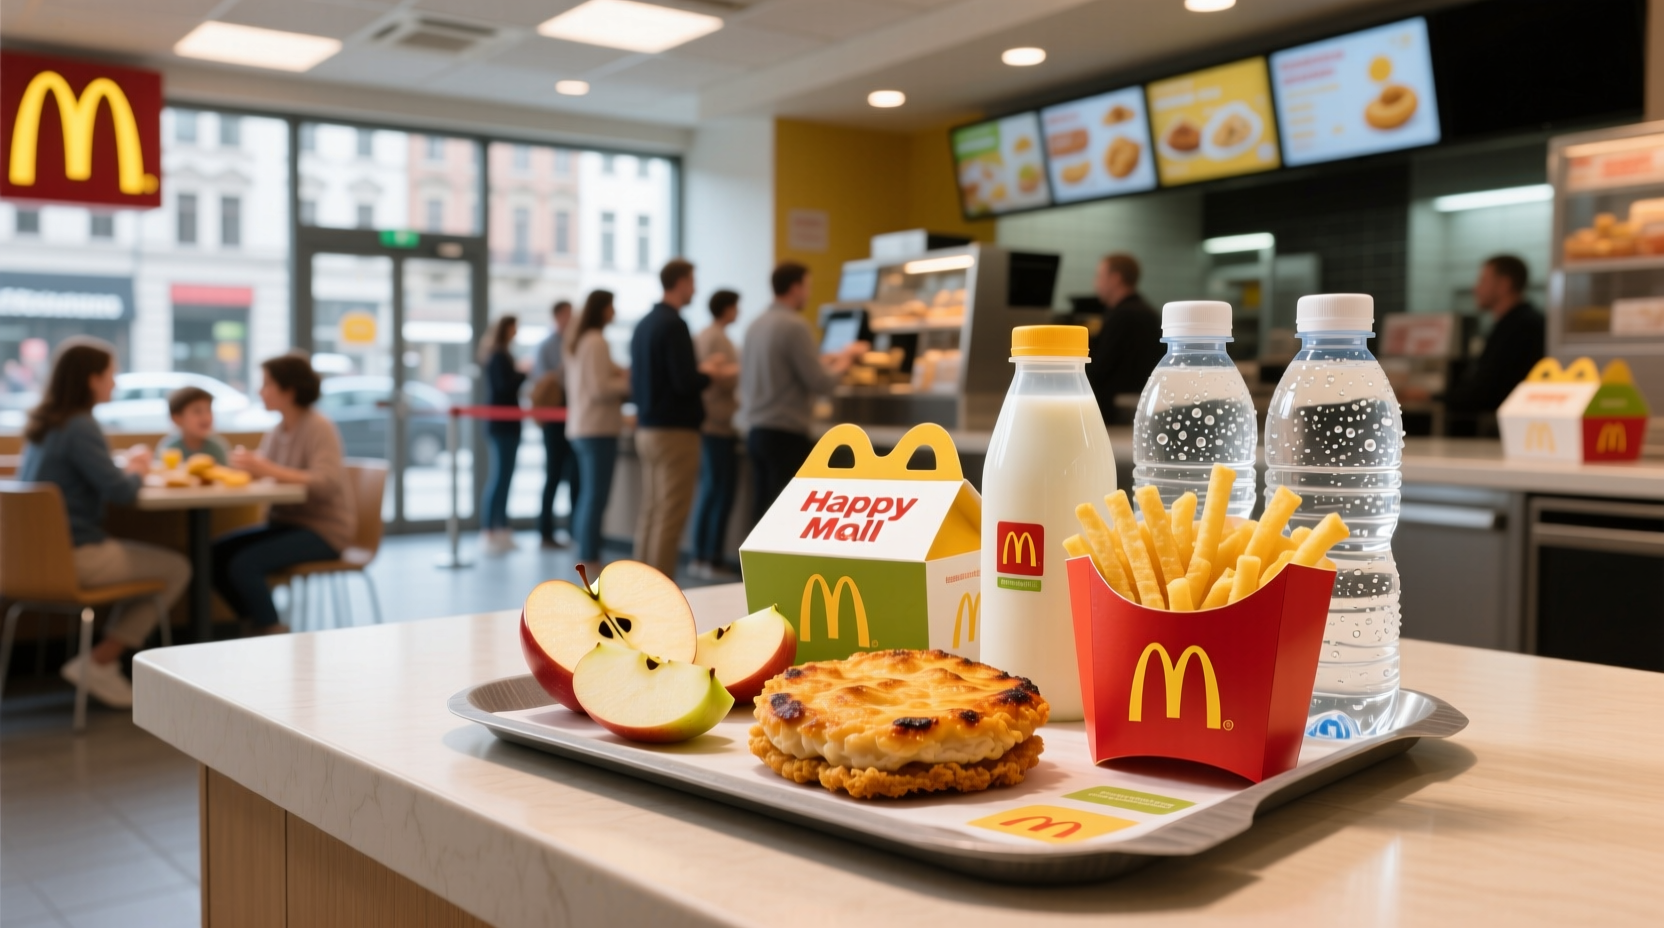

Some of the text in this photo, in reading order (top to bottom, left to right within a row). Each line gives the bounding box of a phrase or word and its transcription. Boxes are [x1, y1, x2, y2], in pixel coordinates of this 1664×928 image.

[8, 70, 145, 195] M
[800, 490, 919, 521] Happy
[1002, 531, 1037, 567] M
[800, 573, 870, 648] M
[1128, 642, 1221, 730] M
